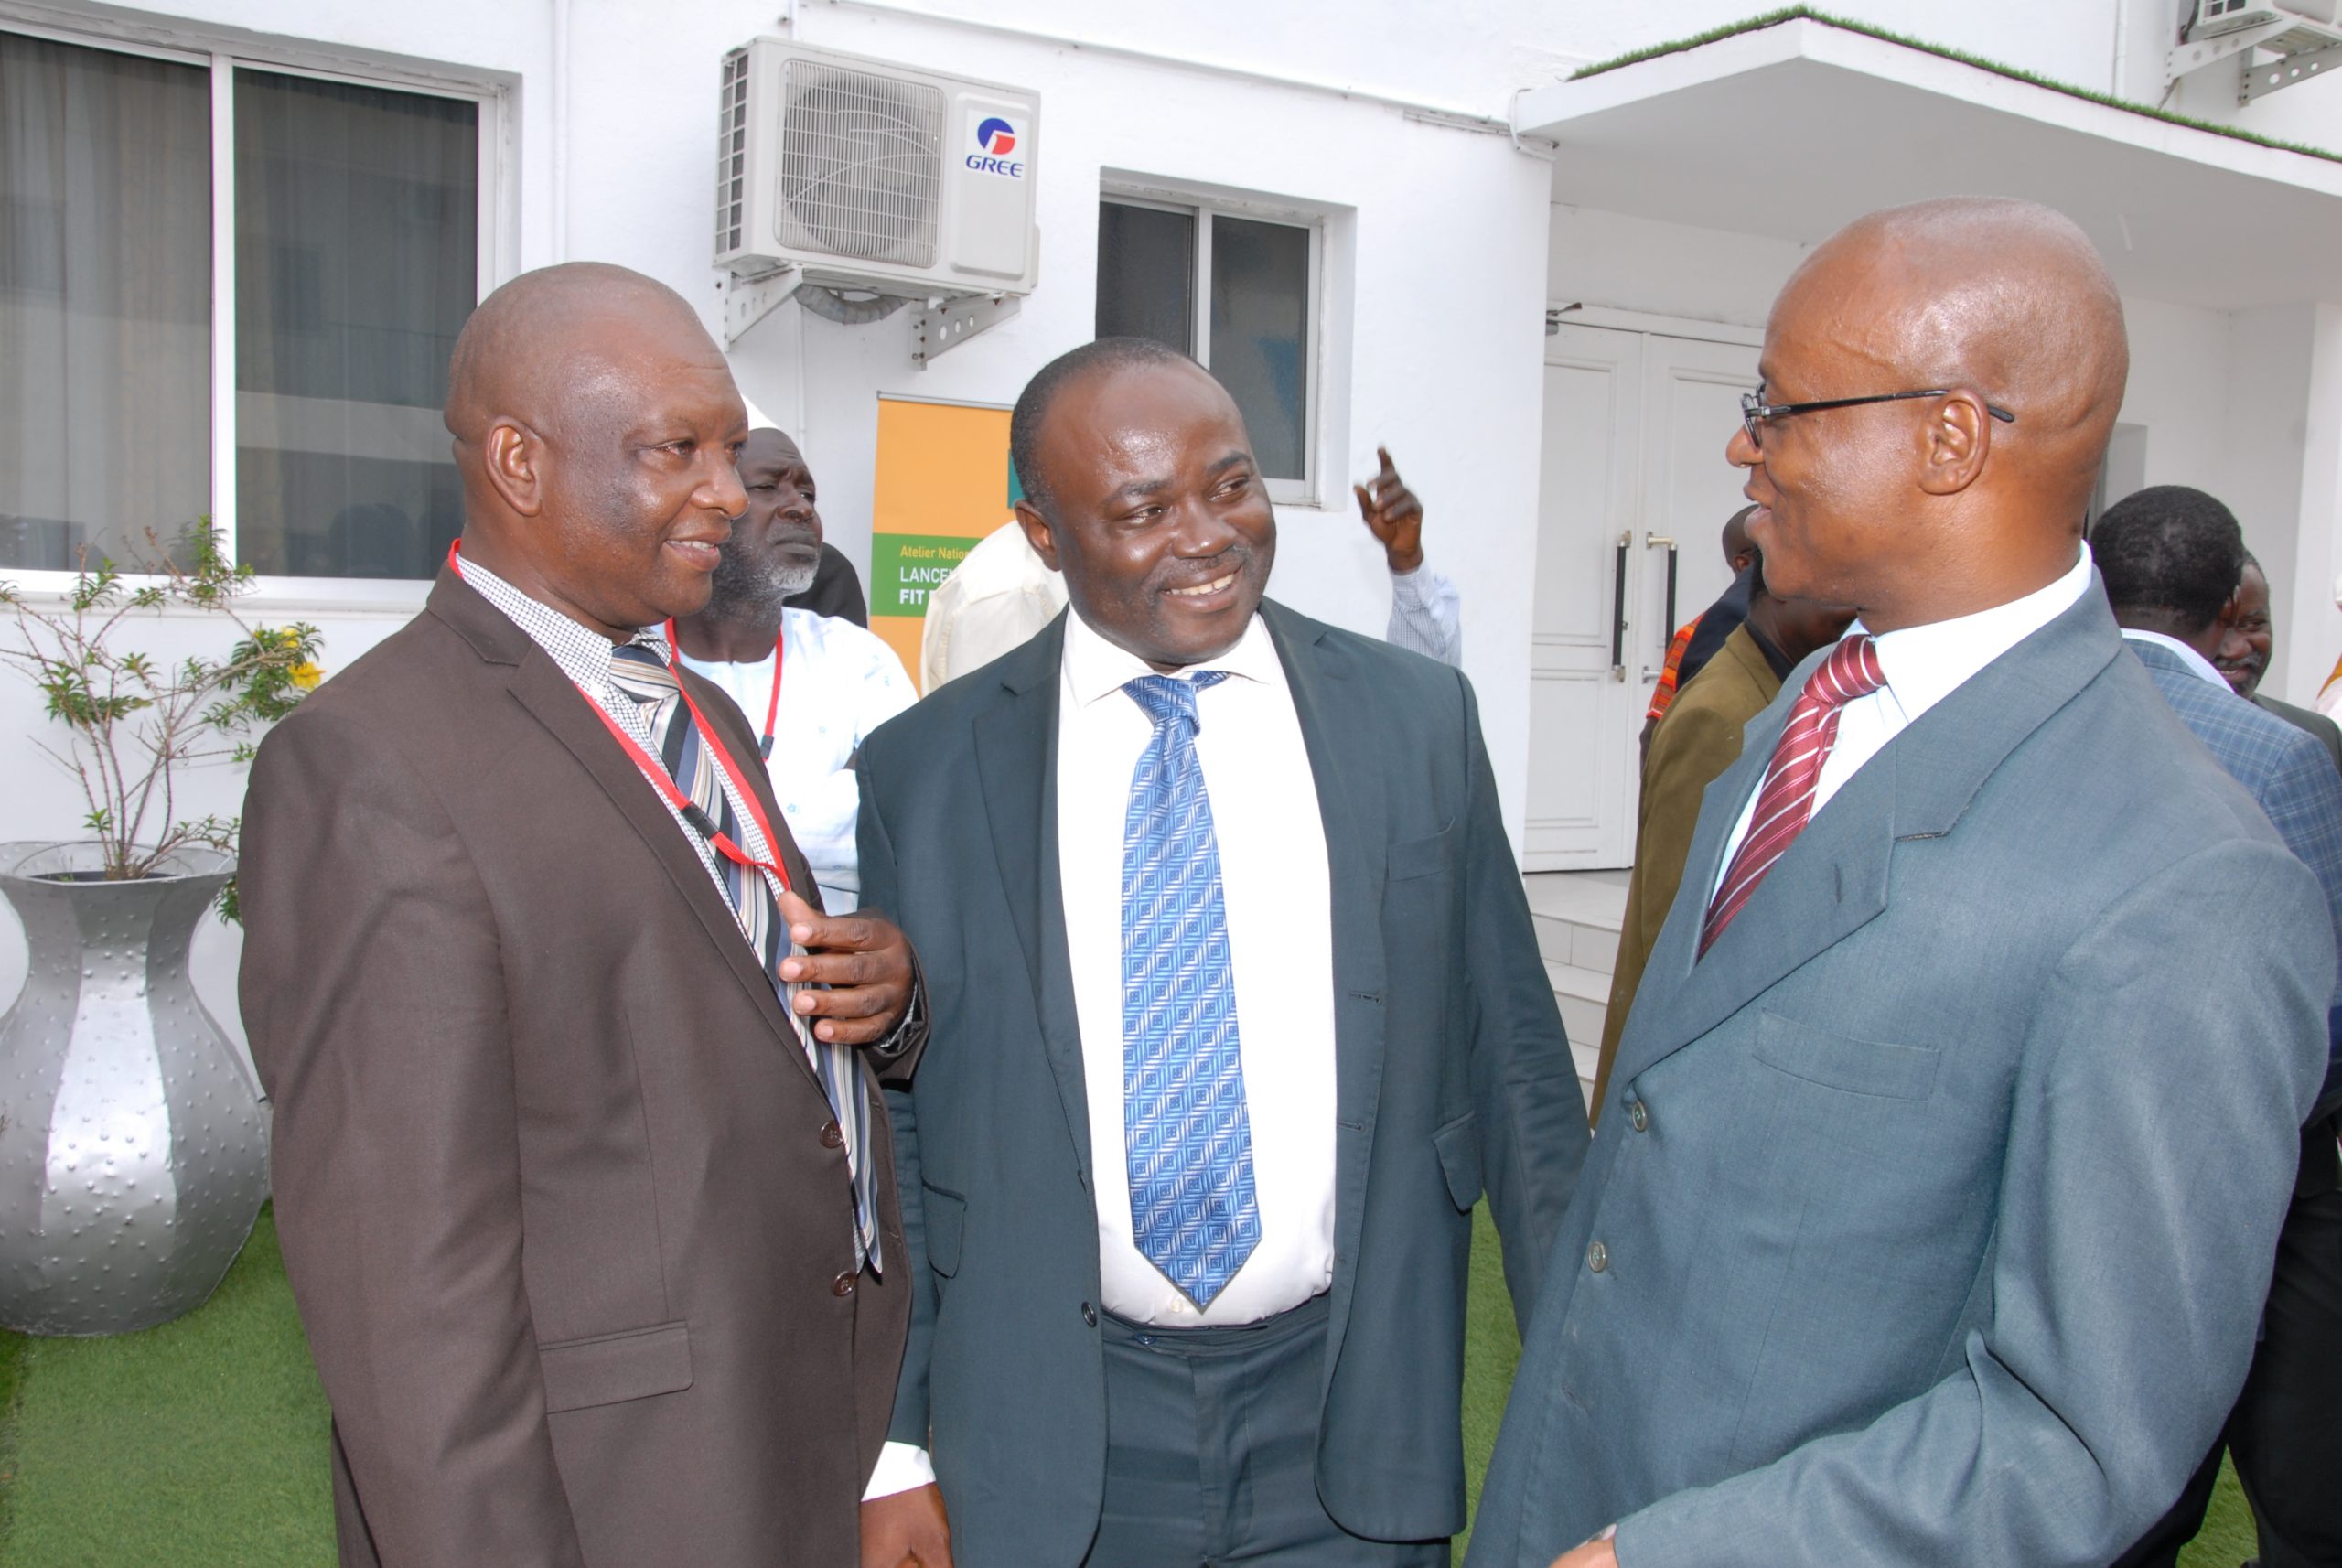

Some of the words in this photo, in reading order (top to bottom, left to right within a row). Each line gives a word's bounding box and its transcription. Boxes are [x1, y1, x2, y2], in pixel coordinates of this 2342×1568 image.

[965, 154, 1024, 178] GREE
[900, 545, 935, 558] Atelier
[900, 566, 954, 583] LANCE
[899, 588, 925, 605] FIT
